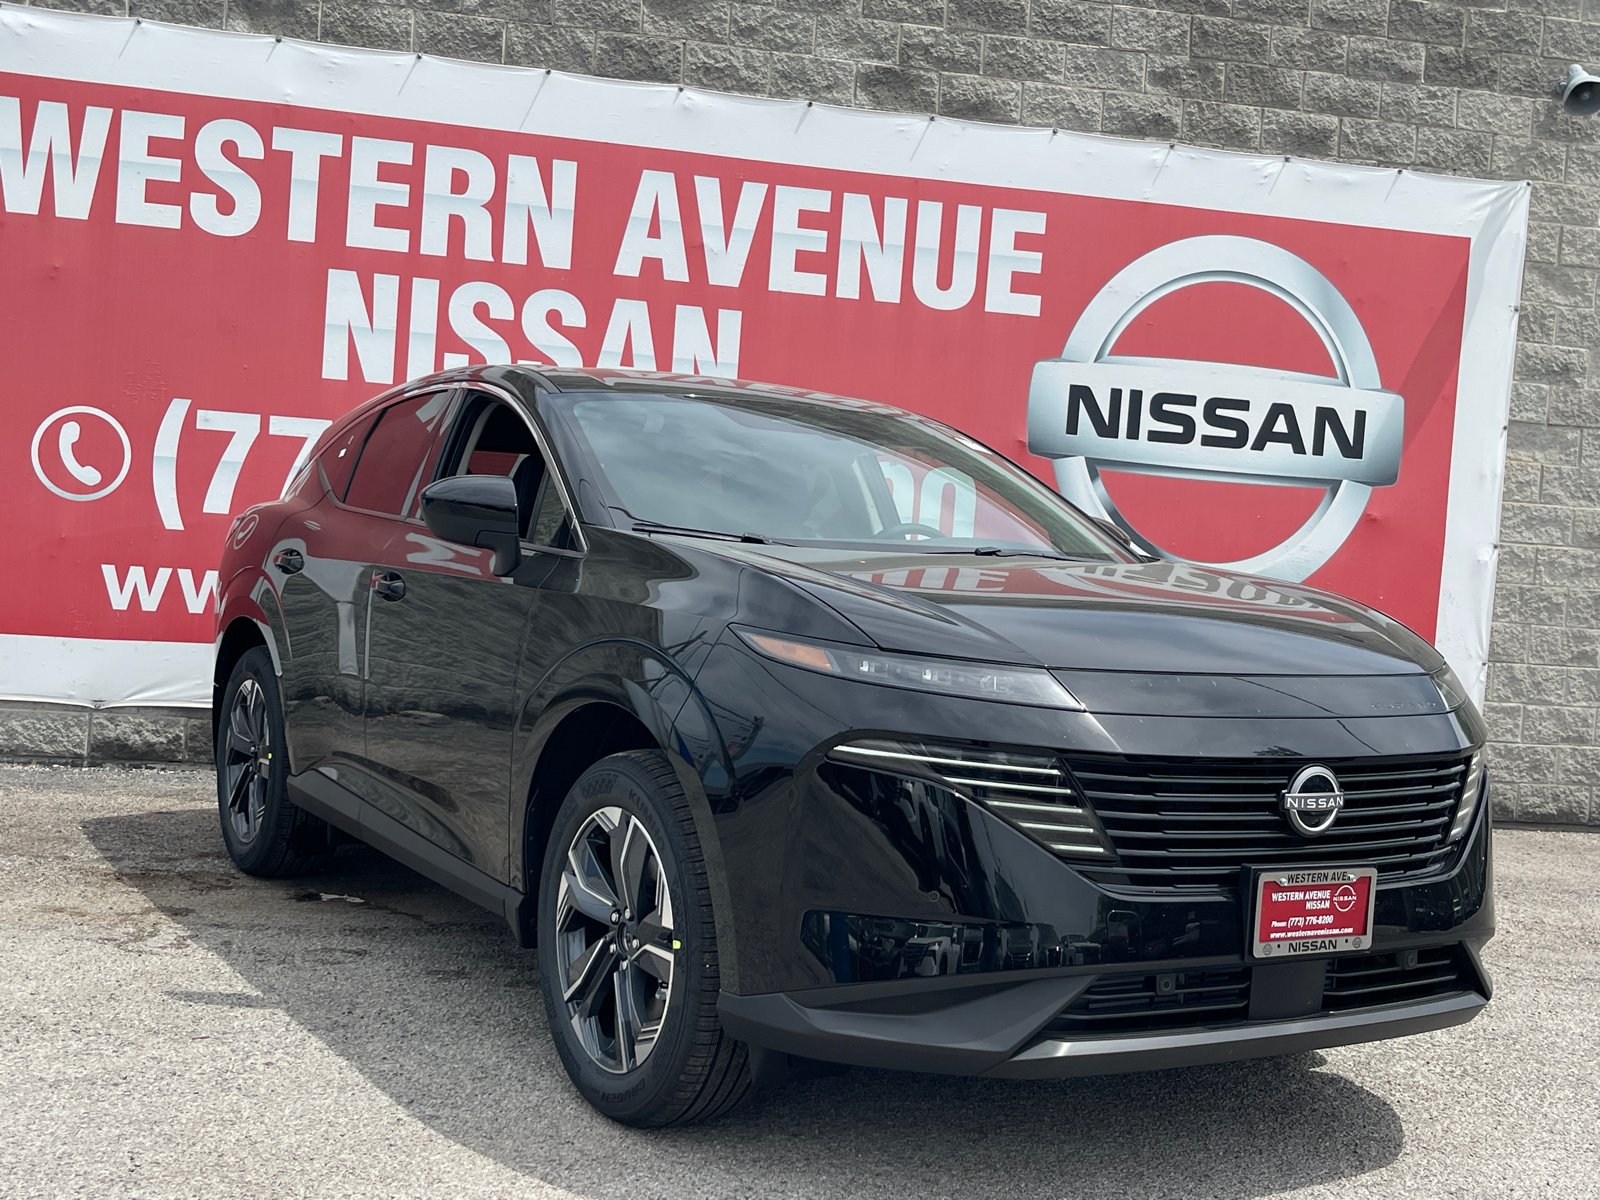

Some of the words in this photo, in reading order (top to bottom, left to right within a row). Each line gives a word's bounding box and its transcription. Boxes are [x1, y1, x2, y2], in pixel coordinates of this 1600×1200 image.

[0, 96, 578, 270] WESTERN
[613, 169, 1048, 318] AVENUE
[321, 268, 743, 385] NISSAN
[1065, 385, 1367, 460] NISSAN
[1286, 796, 1344, 809] NISSAN
[1287, 873, 1329, 884] WESTERN
[1271, 891, 1304, 902] WESTERN
[1304, 889, 1331, 900] AVENUE
[1305, 900, 1331, 910] NISSAN
[1287, 917, 1304, 928] (773)
[1288, 939, 1337, 953] NISSAN
